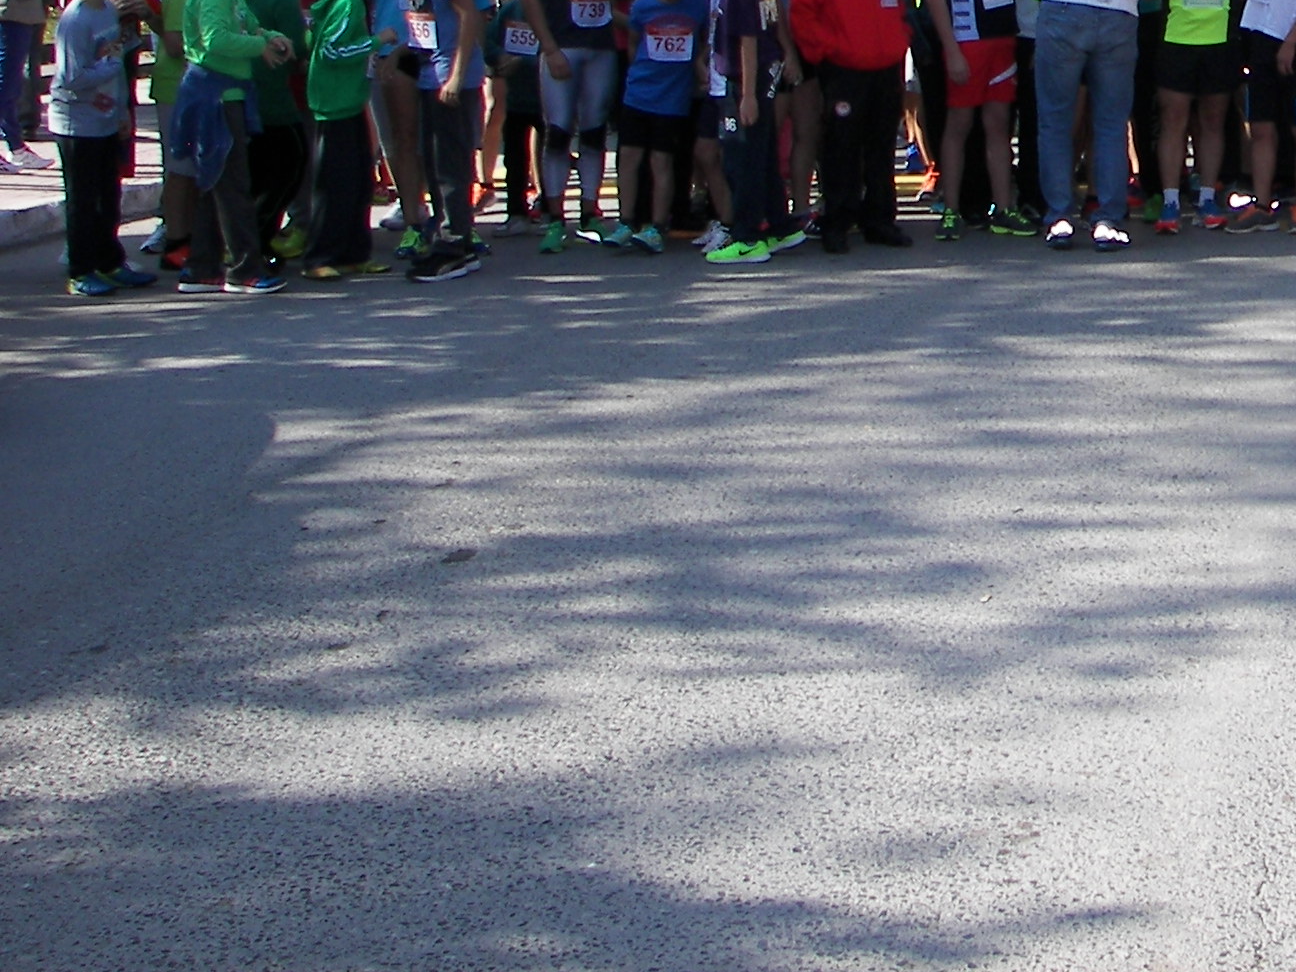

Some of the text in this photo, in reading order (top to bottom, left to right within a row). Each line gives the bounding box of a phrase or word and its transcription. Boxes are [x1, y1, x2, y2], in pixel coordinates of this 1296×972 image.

[578, 3, 606, 18] 739
[511, 30, 537, 46] 559
[654, 37, 686, 53] 762
